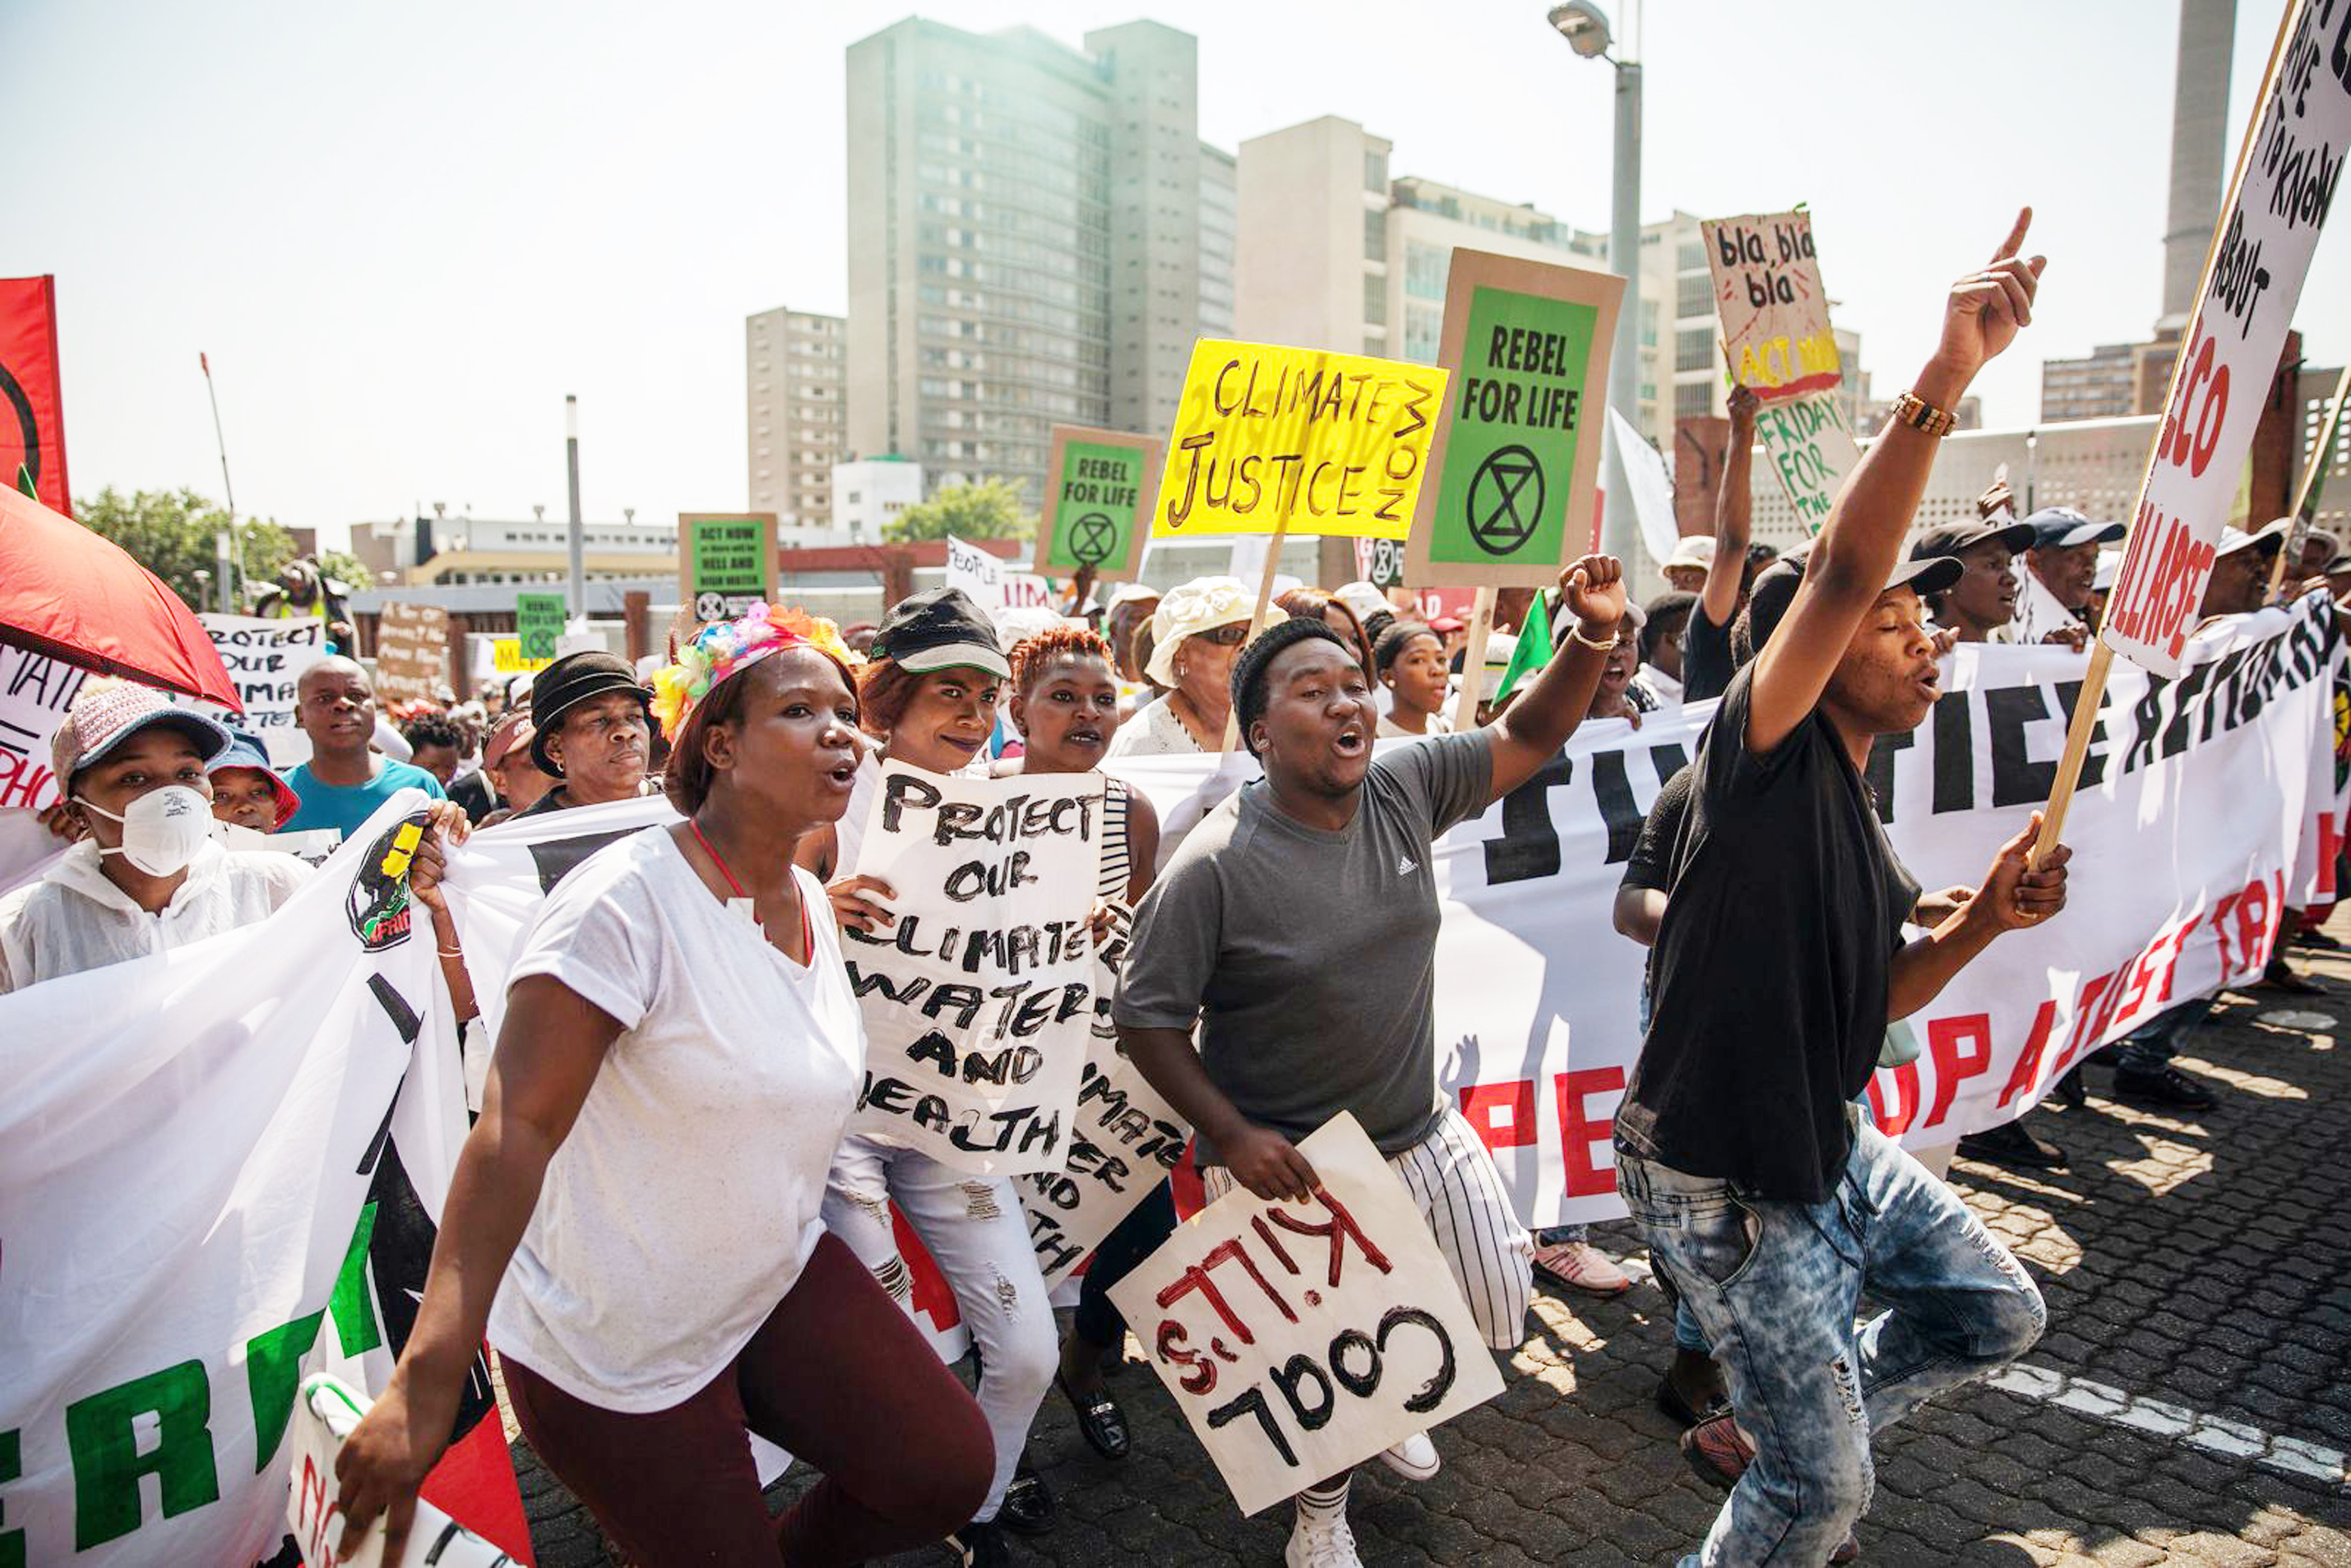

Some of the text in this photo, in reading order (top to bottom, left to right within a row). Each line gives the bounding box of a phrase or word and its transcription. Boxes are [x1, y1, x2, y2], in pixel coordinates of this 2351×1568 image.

[2270, 134, 2344, 230] KNOW
[1717, 224, 1816, 268] bla, bla
[1745, 270, 1795, 308] bla
[1488, 325, 1567, 377] REBEL
[1215, 359, 1395, 424] CLIMATE
[1461, 378, 1579, 430] FOR LIFE
[1374, 378, 1432, 522] NOW
[1756, 398, 1844, 449] FRIDAY
[1063, 482, 1137, 508] FOR LIFE
[1078, 458, 1127, 482] REBEL
[1168, 432, 1366, 528] JUSTICE
[1778, 443, 1839, 497] FOR
[206, 623, 319, 648] ROTECT
[883, 773, 1105, 846] PROTECT
[944, 851, 1038, 903] OUR
[845, 960, 1090, 1039] WATER
[1996, 999, 2057, 1109] A
[2052, 914, 2205, 1077] JUST
[905, 1027, 1044, 1085] AND
